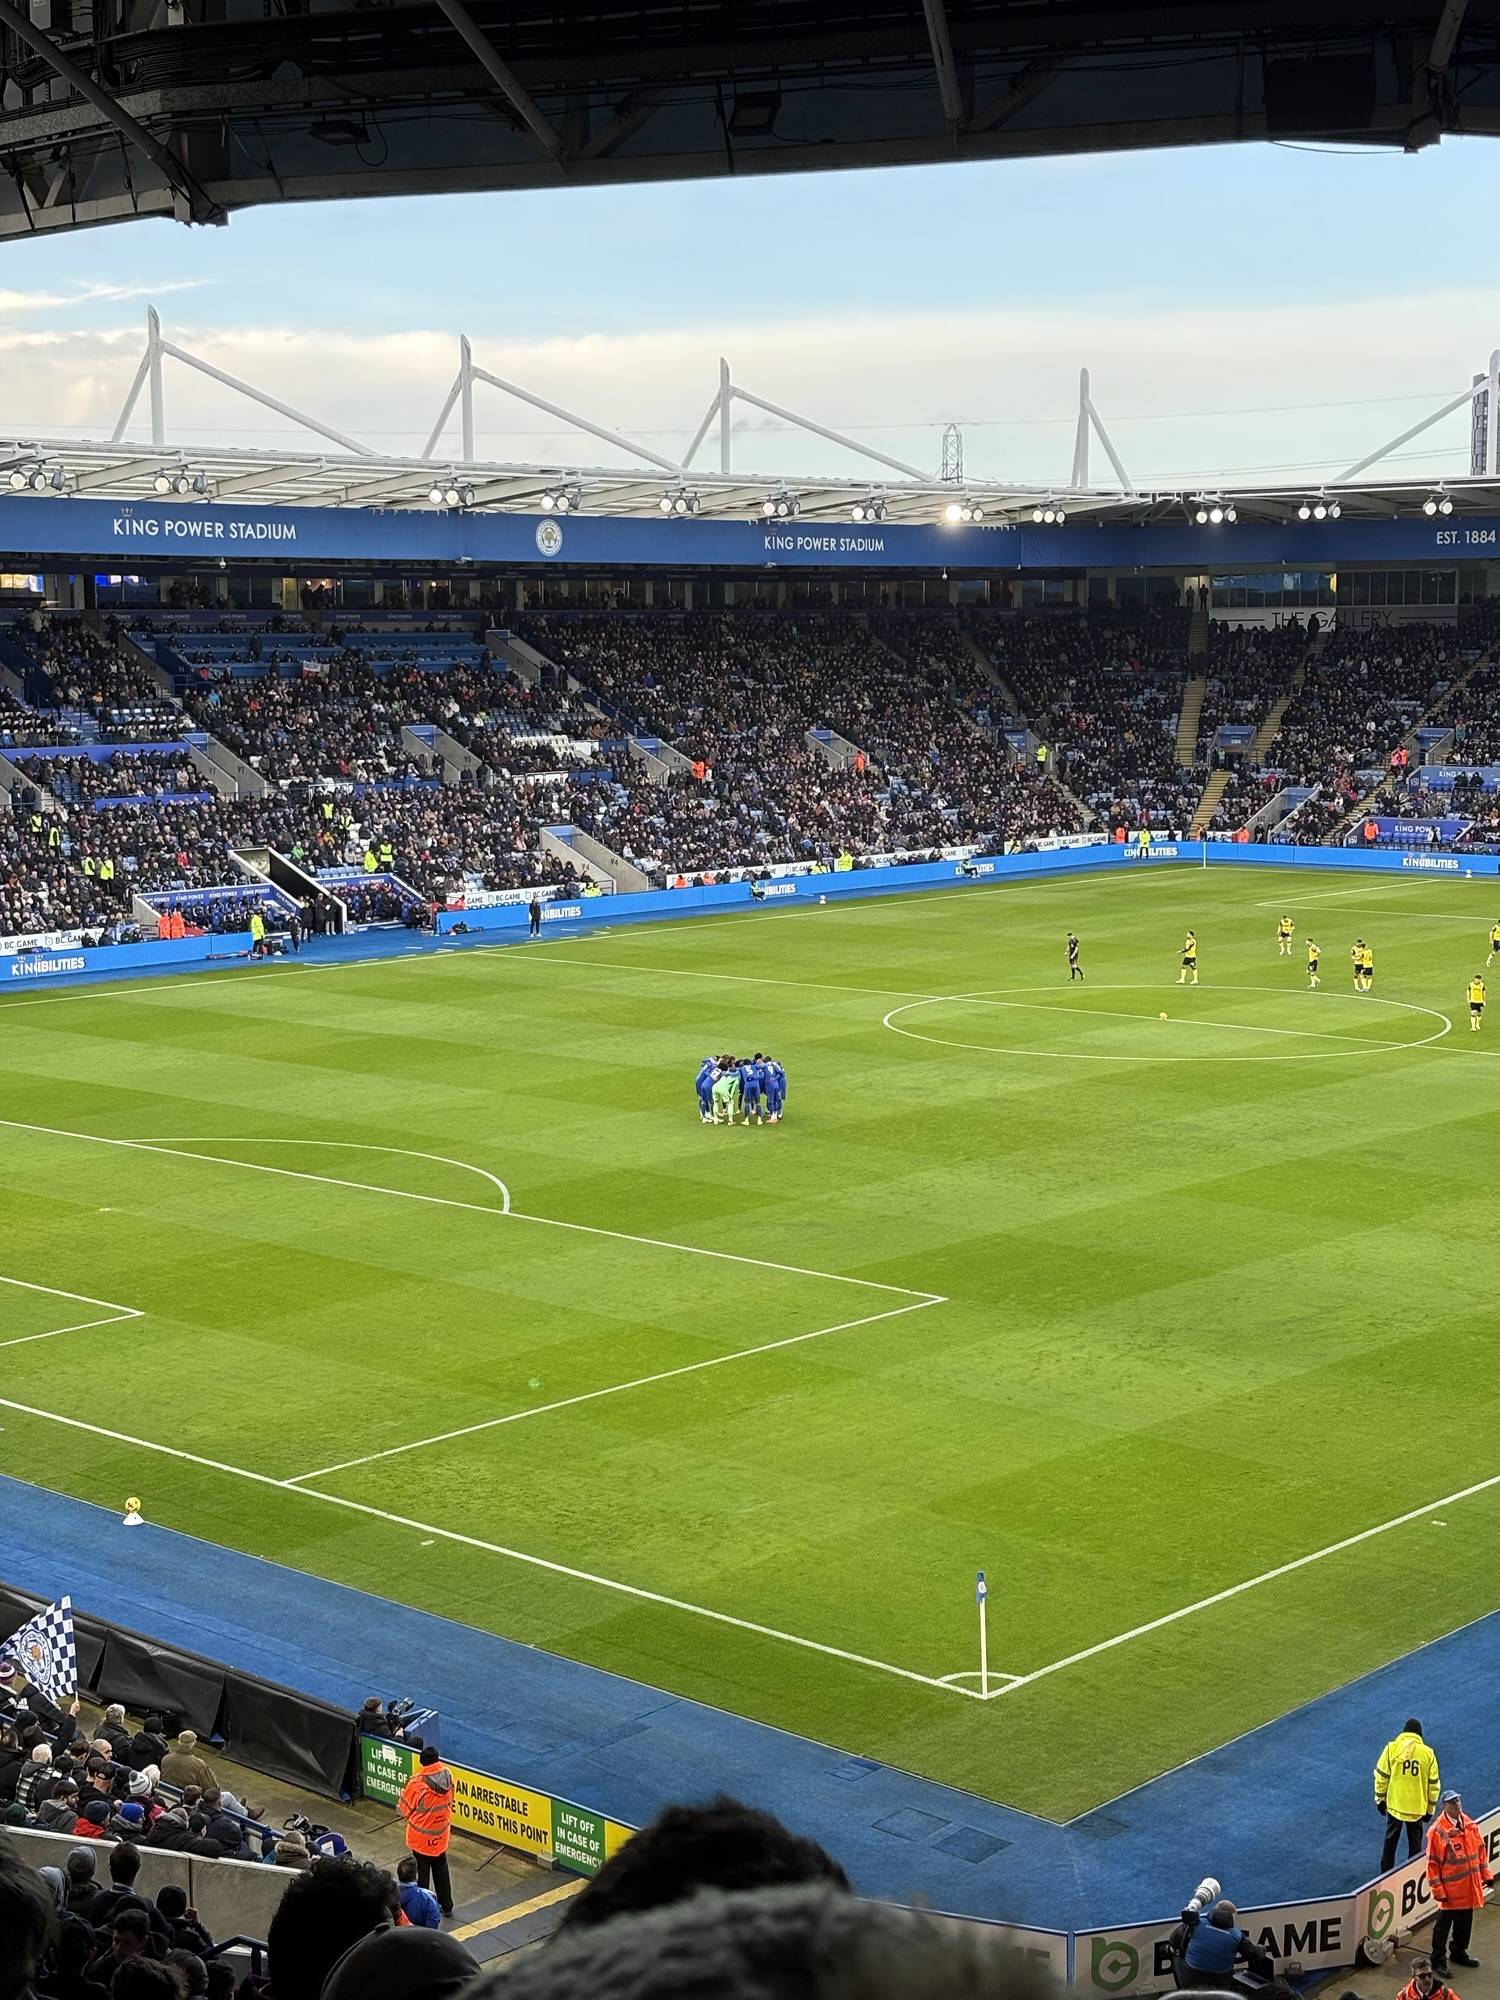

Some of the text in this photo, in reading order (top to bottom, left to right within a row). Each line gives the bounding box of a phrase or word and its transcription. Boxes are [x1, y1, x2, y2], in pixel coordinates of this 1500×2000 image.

[113, 518, 297, 540] KING POWER STADIUM
[1436, 529, 1496, 544] EST. 1884
[764, 536, 884, 552] KING POWER STADIUM
[1314, 610, 1392, 628] GALLERY
[1439, 770, 1457, 778] KING
[1394, 825, 1414, 833] KING
[4, 938, 39, 949] BC.GAME
[367, 1761, 408, 1784] IN CASE OF
[1402, 1759, 1420, 1777] P6
[366, 1775, 406, 1797] EMERGENC
[456, 1780, 469, 1796] AN
[470, 1785, 529, 1817] ARRESTABLE
[458, 1801, 470, 1818] TO
[472, 1806, 495, 1827] PASS
[496, 1814, 518, 1835] THIS
[520, 1822, 549, 1845] POINT
[561, 1811, 595, 1835] LIFT OFF
[557, 1826, 600, 1853] IN CASE OF
[555, 1841, 603, 1869] EMERGENCY
